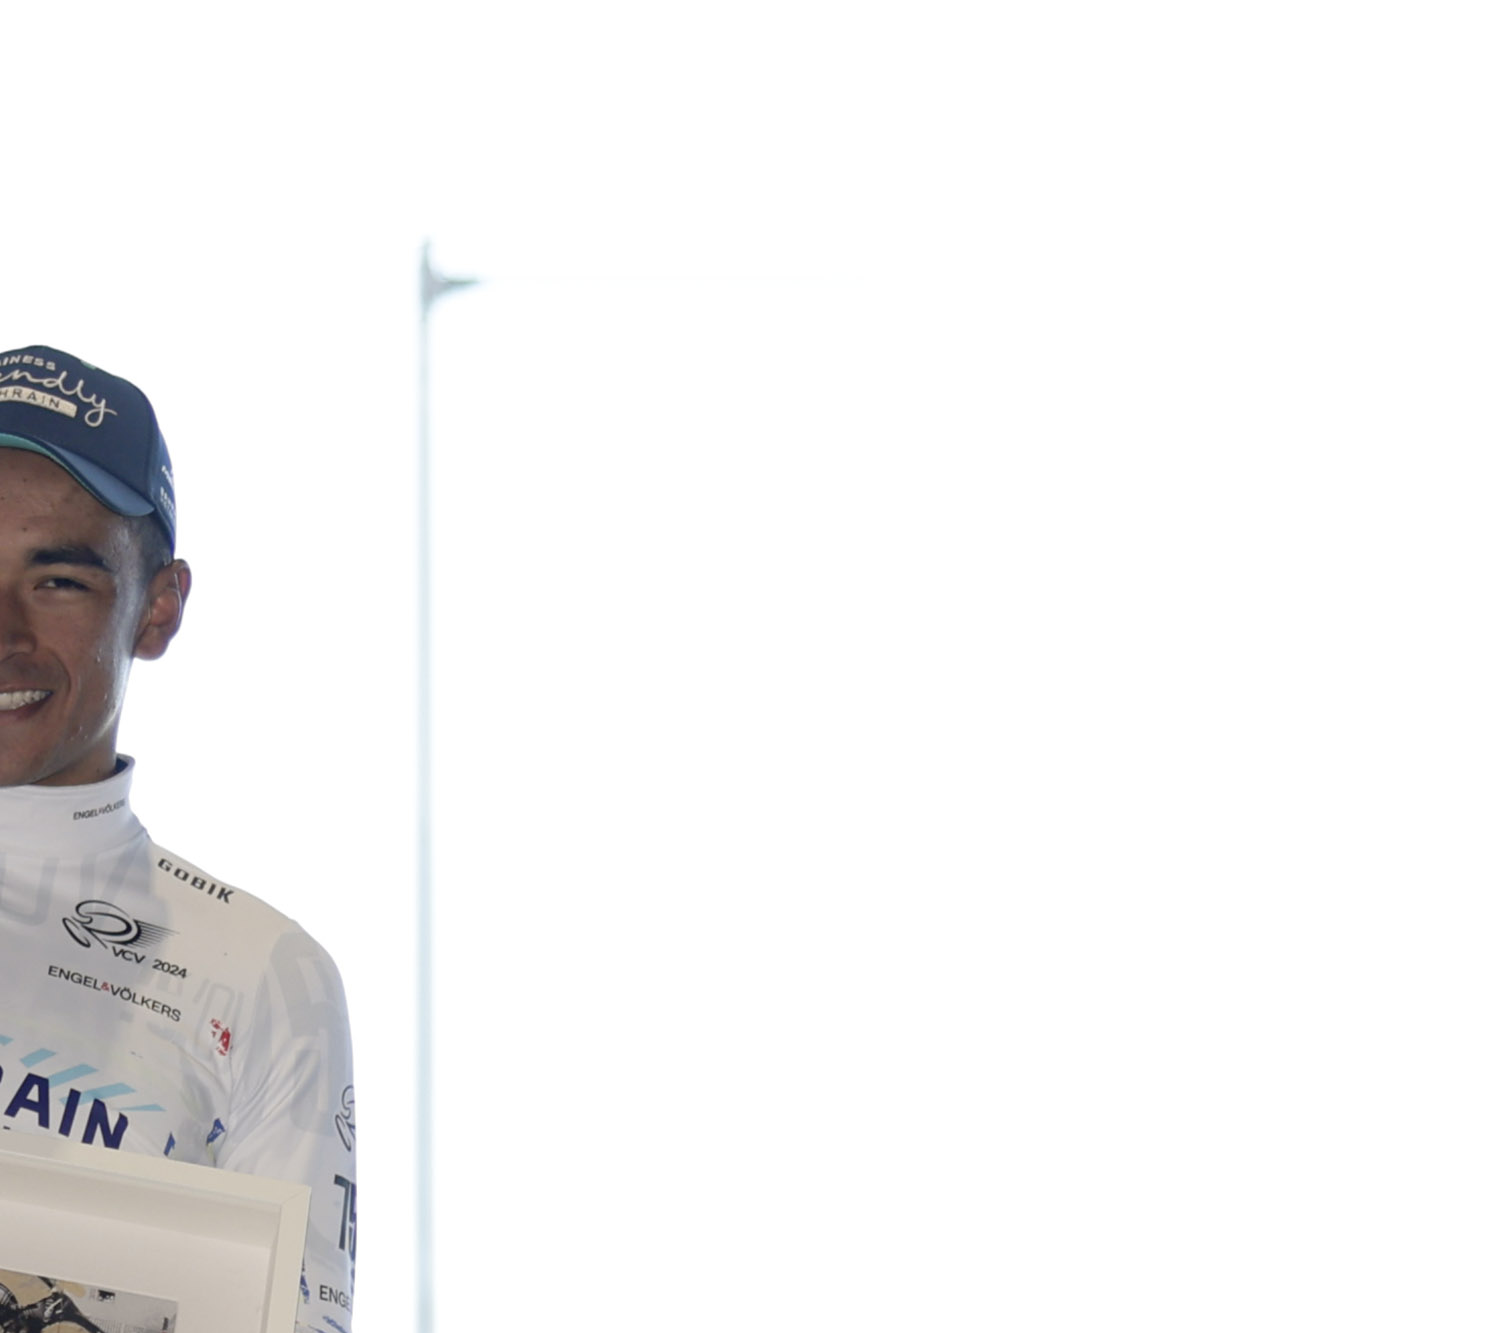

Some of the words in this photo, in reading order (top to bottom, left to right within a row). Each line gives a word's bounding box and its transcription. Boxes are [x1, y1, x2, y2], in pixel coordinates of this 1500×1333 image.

[156, 858, 235, 904] GOBIK
[111, 945, 146, 964] VCV
[152, 959, 188, 980] 2024
